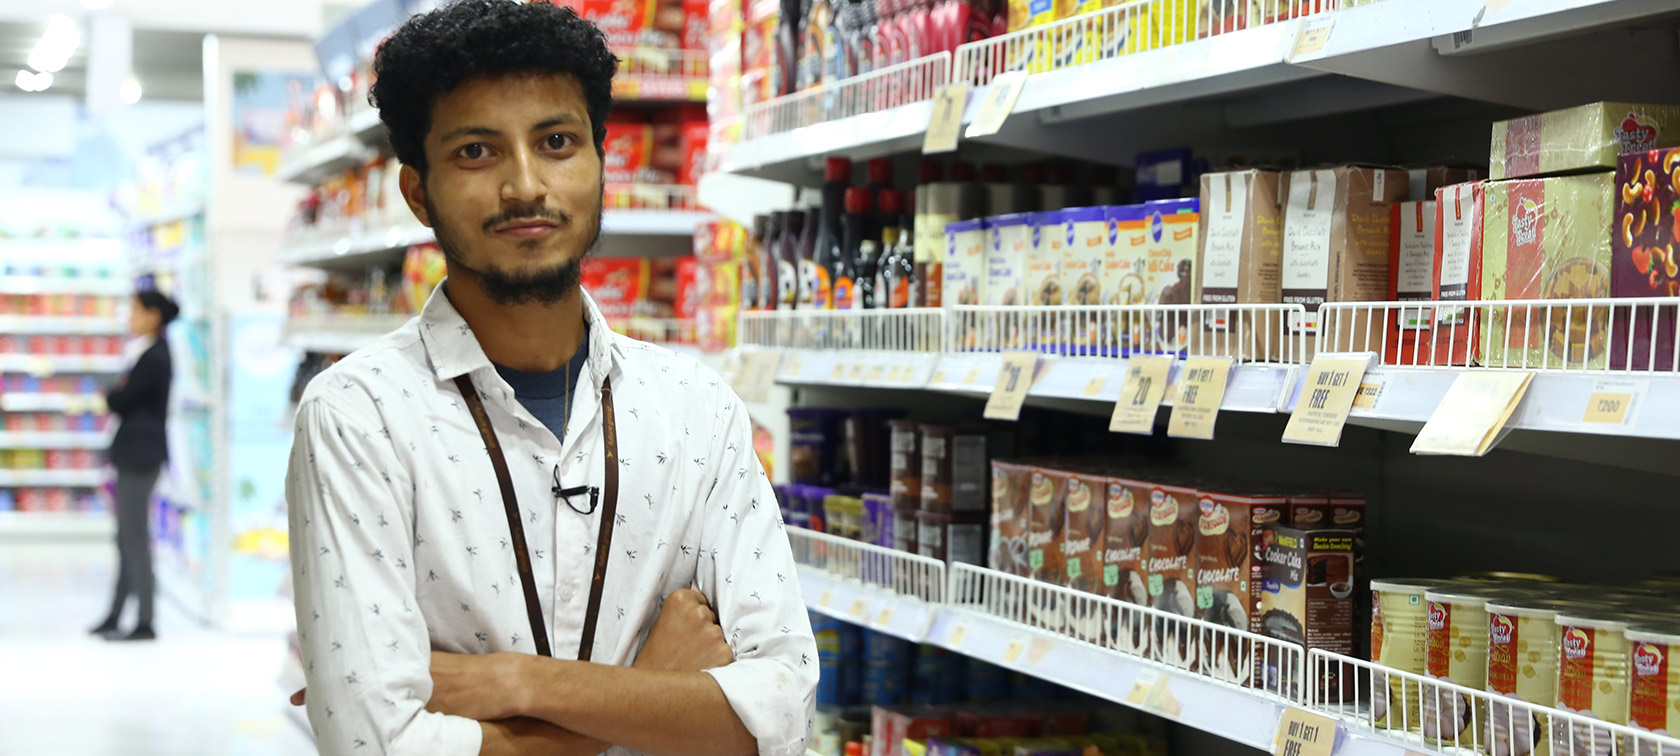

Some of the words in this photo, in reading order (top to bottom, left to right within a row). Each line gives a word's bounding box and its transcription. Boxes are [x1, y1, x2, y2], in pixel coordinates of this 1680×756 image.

[1614, 127, 1650, 145] Tasty
[1512, 213, 1533, 234] Tasty
[1202, 294, 1212, 303] FREE
[1212, 294, 1222, 303] FROM
[1222, 294, 1236, 303] GLUTEN
[1284, 296, 1295, 304] FREE
[1295, 296, 1307, 304] FROM
[1307, 296, 1324, 304] GLUTEN
[1200, 369, 1211, 382] GET
[1317, 371, 1330, 385] BUY
[1332, 372, 1344, 386] GET
[1342, 370, 1350, 387] 1
[1132, 376, 1152, 405] 20
[1182, 385, 1199, 404] FREE
[1308, 388, 1331, 409] FREE
[1597, 399, 1621, 413] ₹200
[1104, 546, 1142, 563] CHOCOLATE
[1266, 546, 1287, 565] Cooker
[1287, 551, 1302, 569] Cake
[1149, 555, 1188, 573] CHOCOLATE
[1197, 566, 1240, 585] CHOCOLATE
[1289, 569, 1299, 581] Mix
[1563, 637, 1581, 649] Tasty
[1634, 653, 1655, 665] Tasty
[1288, 720, 1300, 738] BUY
[1299, 721, 1305, 739] 1
[1303, 725, 1315, 742] GET
[1313, 726, 1319, 743] 1
[1283, 739, 1302, 756] FREE
